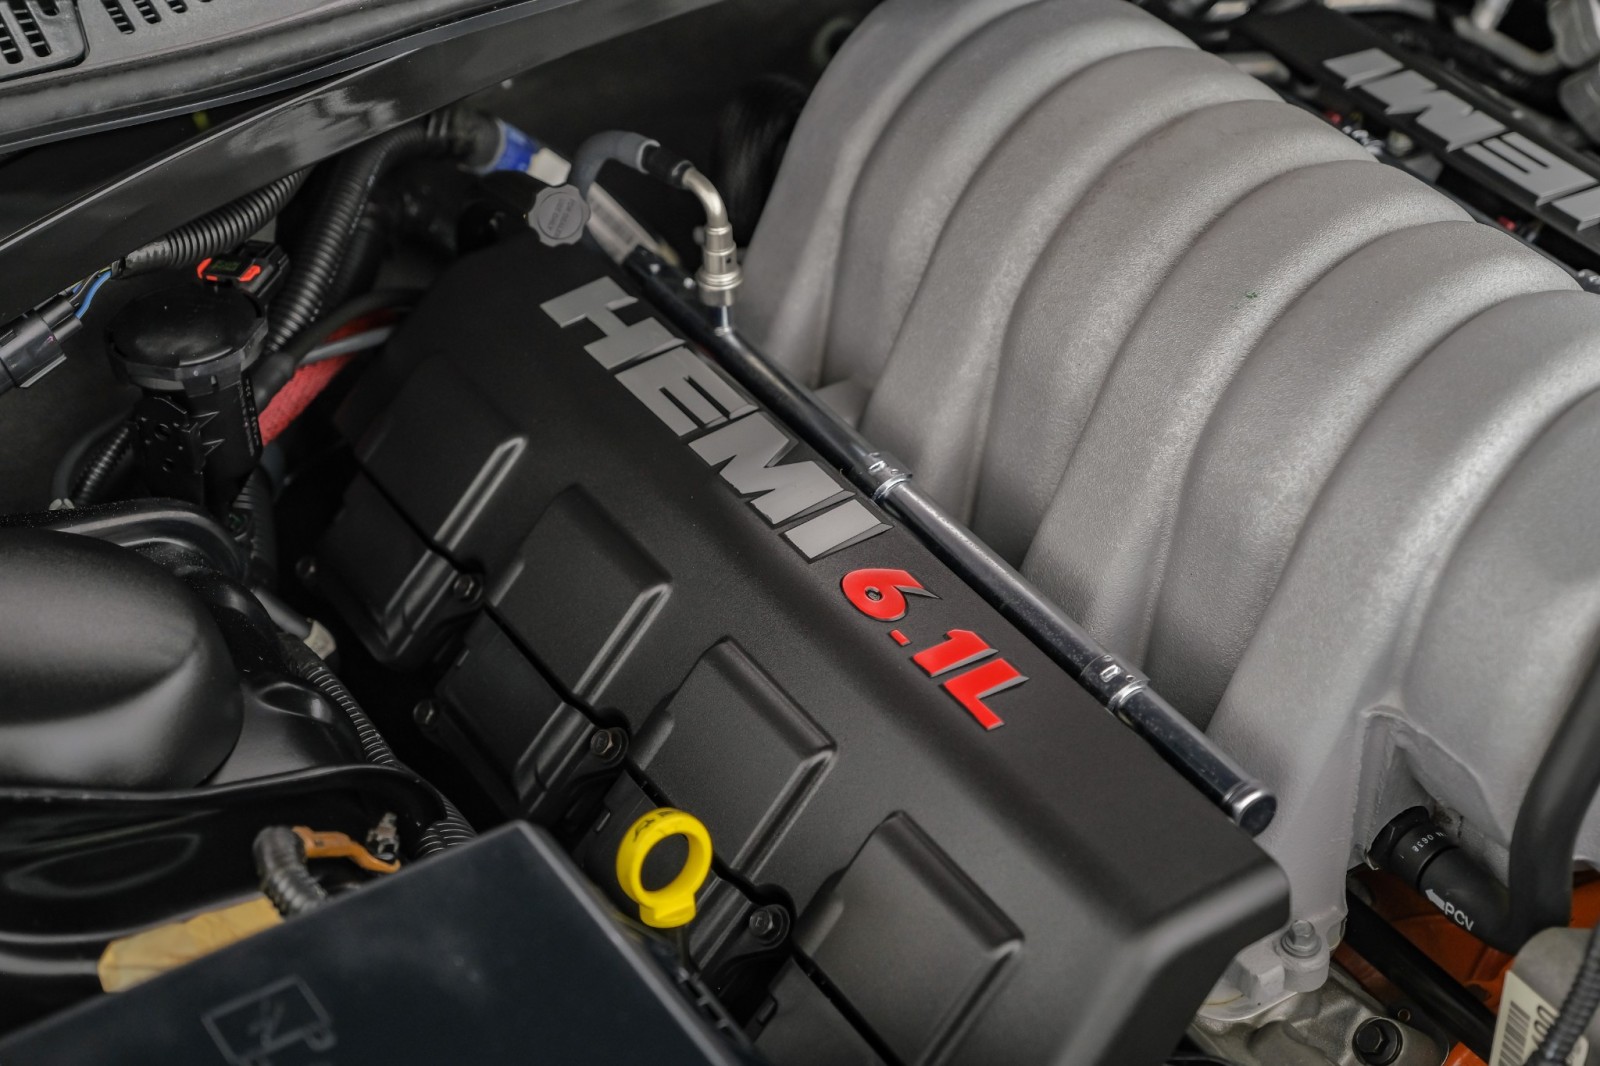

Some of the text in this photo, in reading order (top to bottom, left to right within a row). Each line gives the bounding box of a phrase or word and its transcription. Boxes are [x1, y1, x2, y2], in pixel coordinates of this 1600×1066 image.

[540, 276, 1030, 731] HEMI 6.1L
[1445, 902, 1473, 931] PCV
